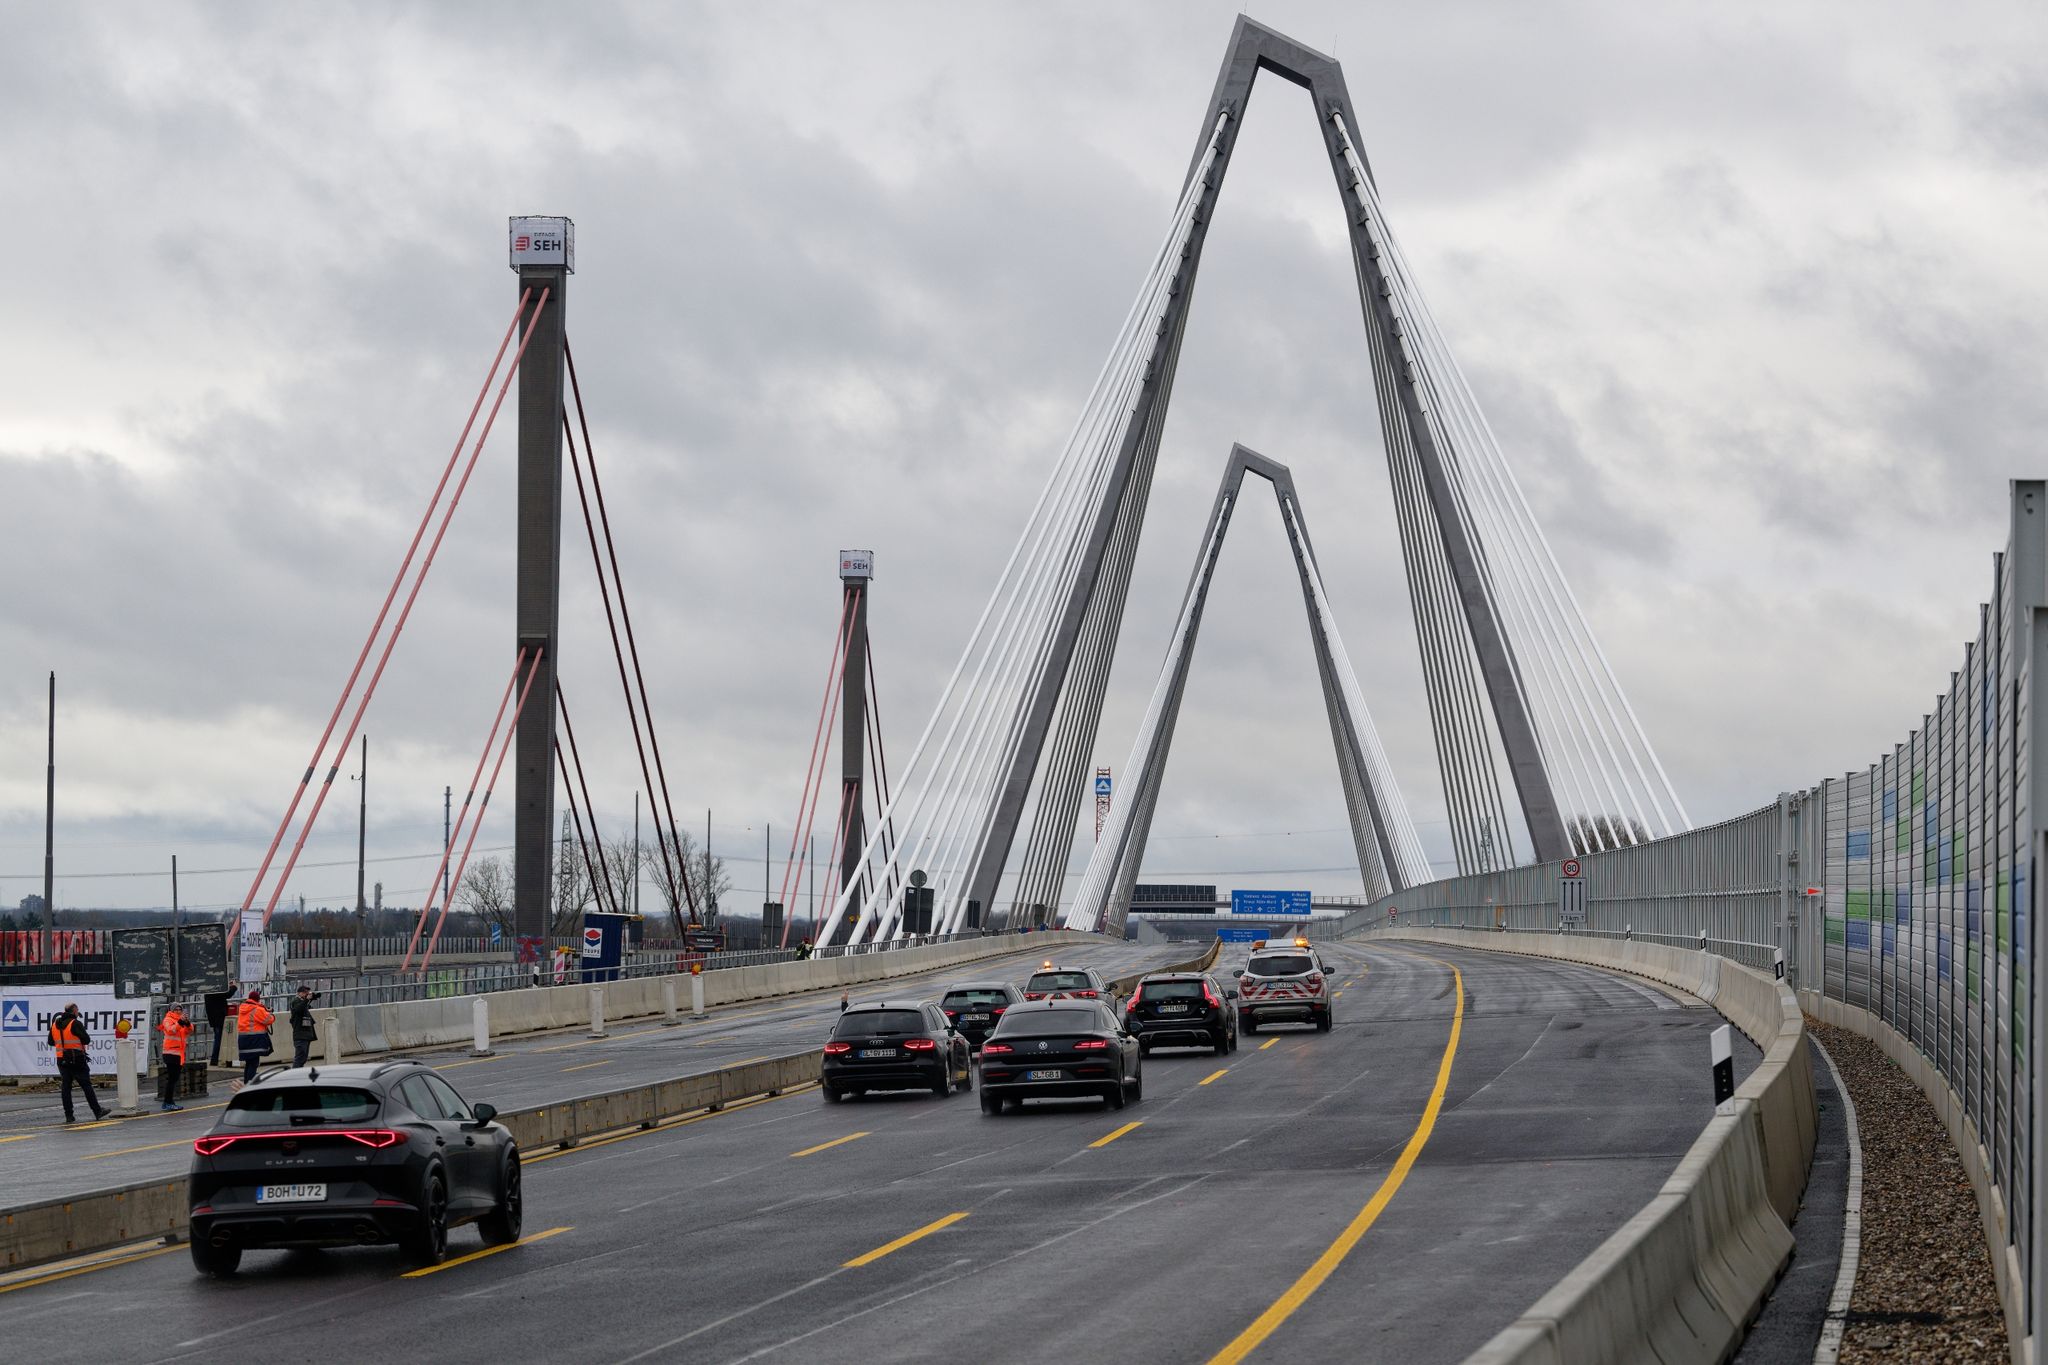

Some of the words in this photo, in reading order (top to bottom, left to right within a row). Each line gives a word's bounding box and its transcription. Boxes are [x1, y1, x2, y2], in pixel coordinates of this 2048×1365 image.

[534, 239, 561, 251] SEH
[853, 562, 868, 570] SEH
[1566, 864, 1577, 873] 80
[267, 1187, 290, 1198] BOH
